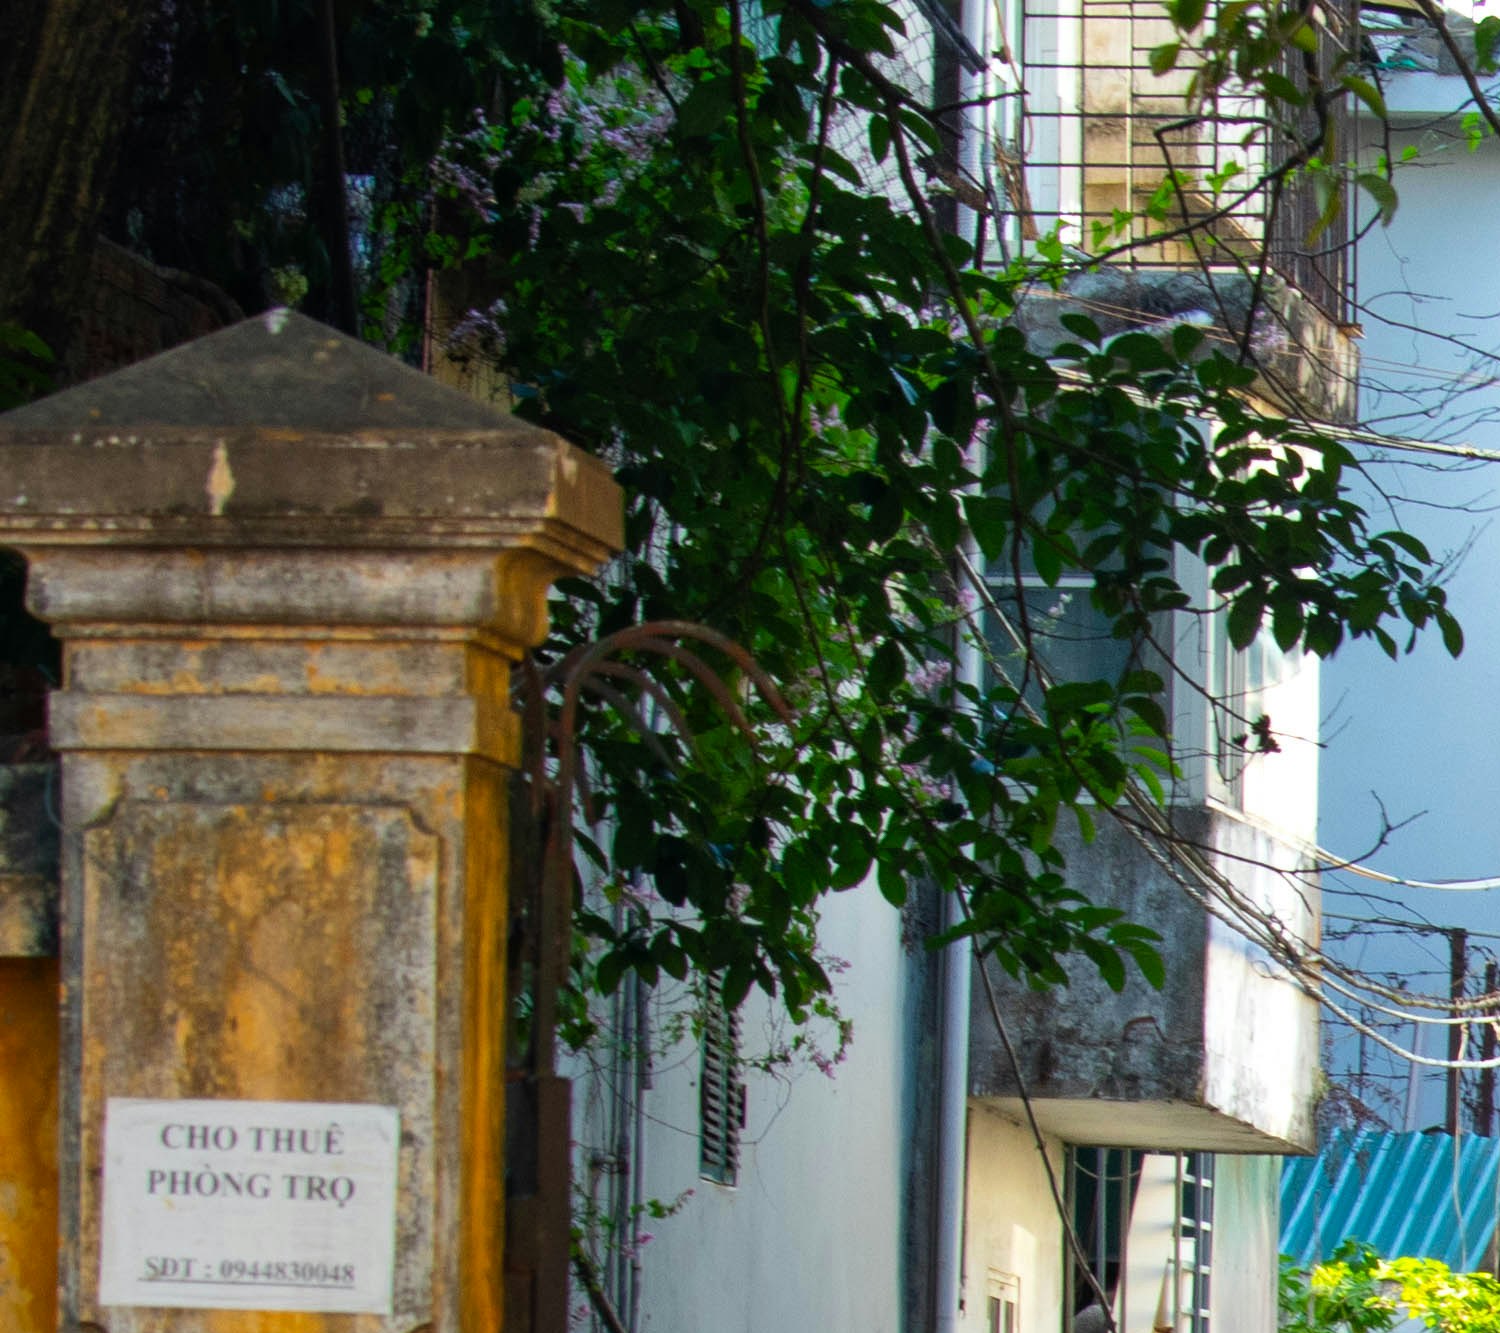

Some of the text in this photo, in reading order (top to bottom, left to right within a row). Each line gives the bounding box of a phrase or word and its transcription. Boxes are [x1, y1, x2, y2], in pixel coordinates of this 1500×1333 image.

[160, 1121, 345, 1155] CHO THUÊ
[147, 1163, 356, 1208] PHÒNG TRỌ
